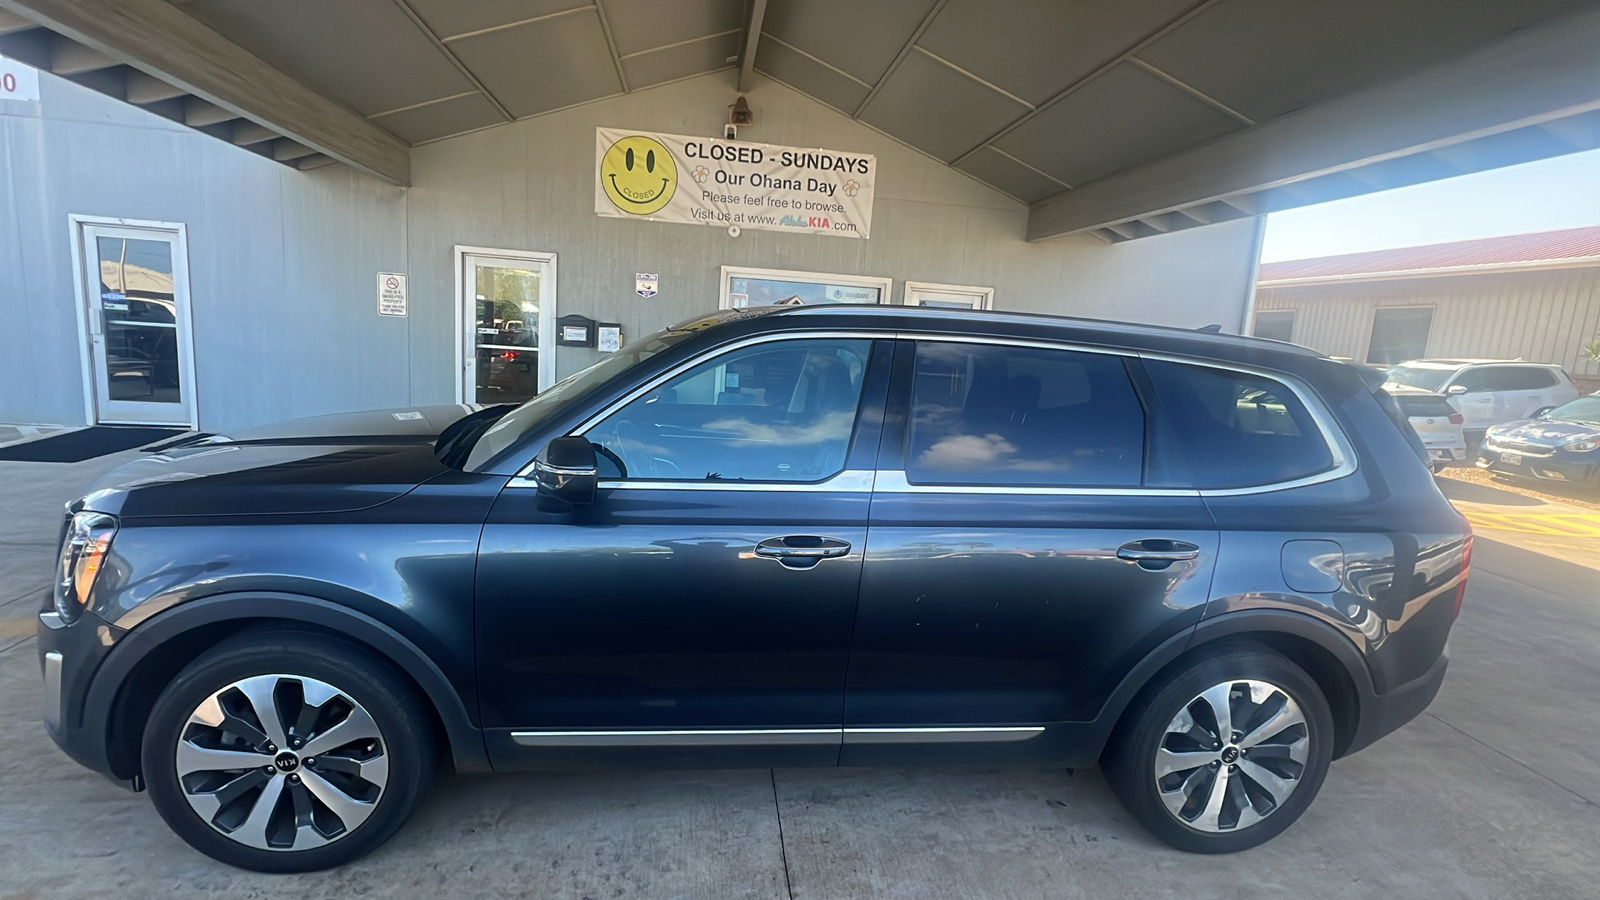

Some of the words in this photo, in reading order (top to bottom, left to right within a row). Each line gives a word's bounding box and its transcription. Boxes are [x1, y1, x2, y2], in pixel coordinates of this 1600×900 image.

[684, 142, 763, 164] CLOSED
[781, 151, 869, 174] SUNDAYS
[714, 169, 745, 185] Our
[750, 173, 802, 191] Ohana
[807, 178, 837, 197] Day
[623, 187, 655, 200] CLOSED
[702, 190, 740, 204] Please
[743, 194, 764, 206] feel
[767, 196, 788, 208] free
[791, 199, 802, 209] to
[805, 199, 847, 213] browse.
[690, 207, 714, 220] Visit
[717, 212, 731, 221] us
[733, 212, 745, 222] at
[747, 215, 777, 225] www.
[277, 758, 296, 767] KIA
